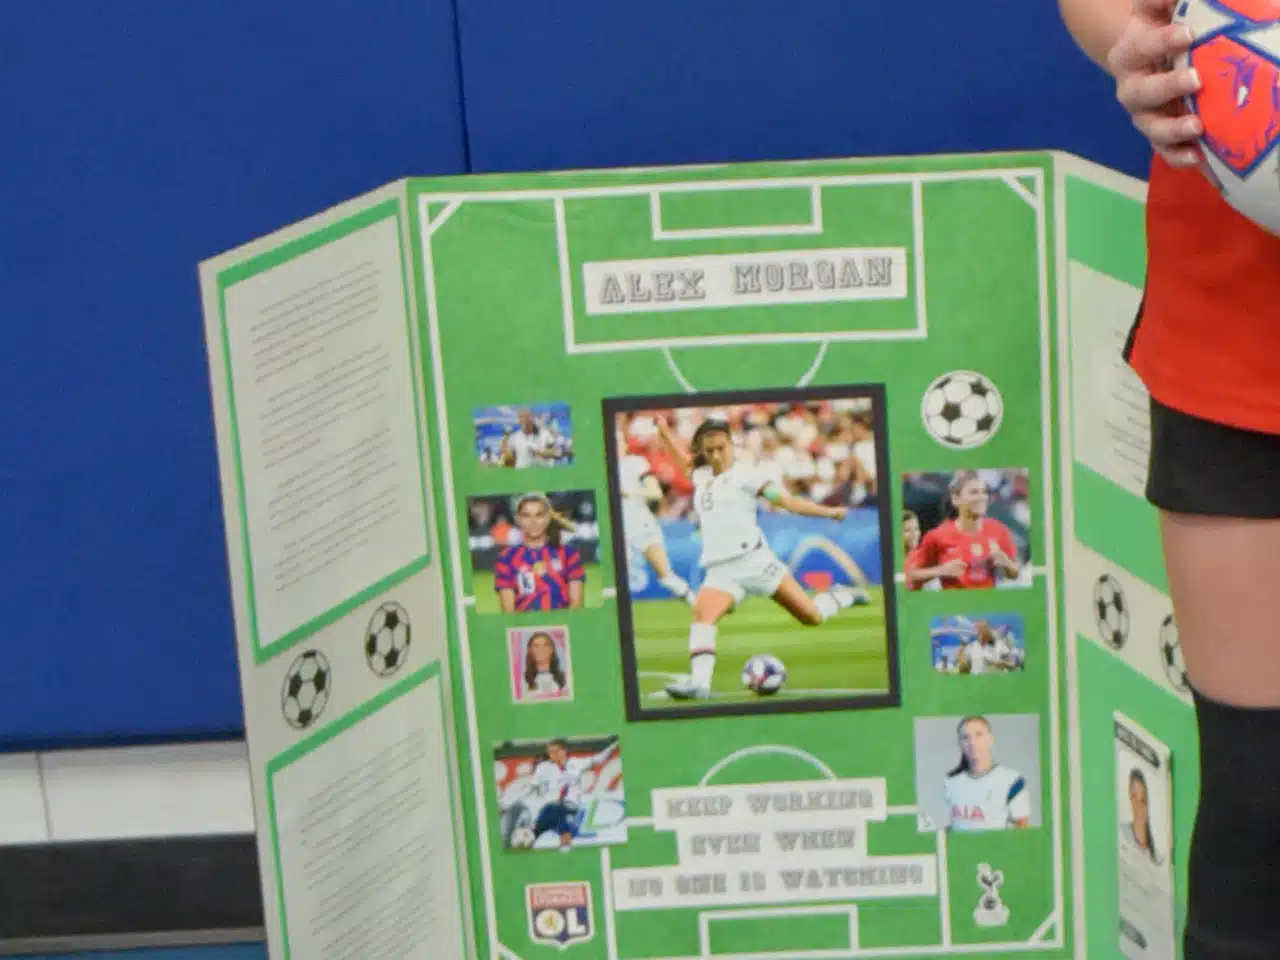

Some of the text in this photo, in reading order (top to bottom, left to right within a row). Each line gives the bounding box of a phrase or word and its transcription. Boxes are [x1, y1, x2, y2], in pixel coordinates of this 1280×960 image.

[600, 256, 893, 305] ALEX MORGAN
[666, 788, 874, 818] KEEP WORKING
[690, 827, 856, 856] EVEN WHEN
[628, 863, 923, 898] NO ONE IS WATCHING
[536, 907, 586, 936] OL
